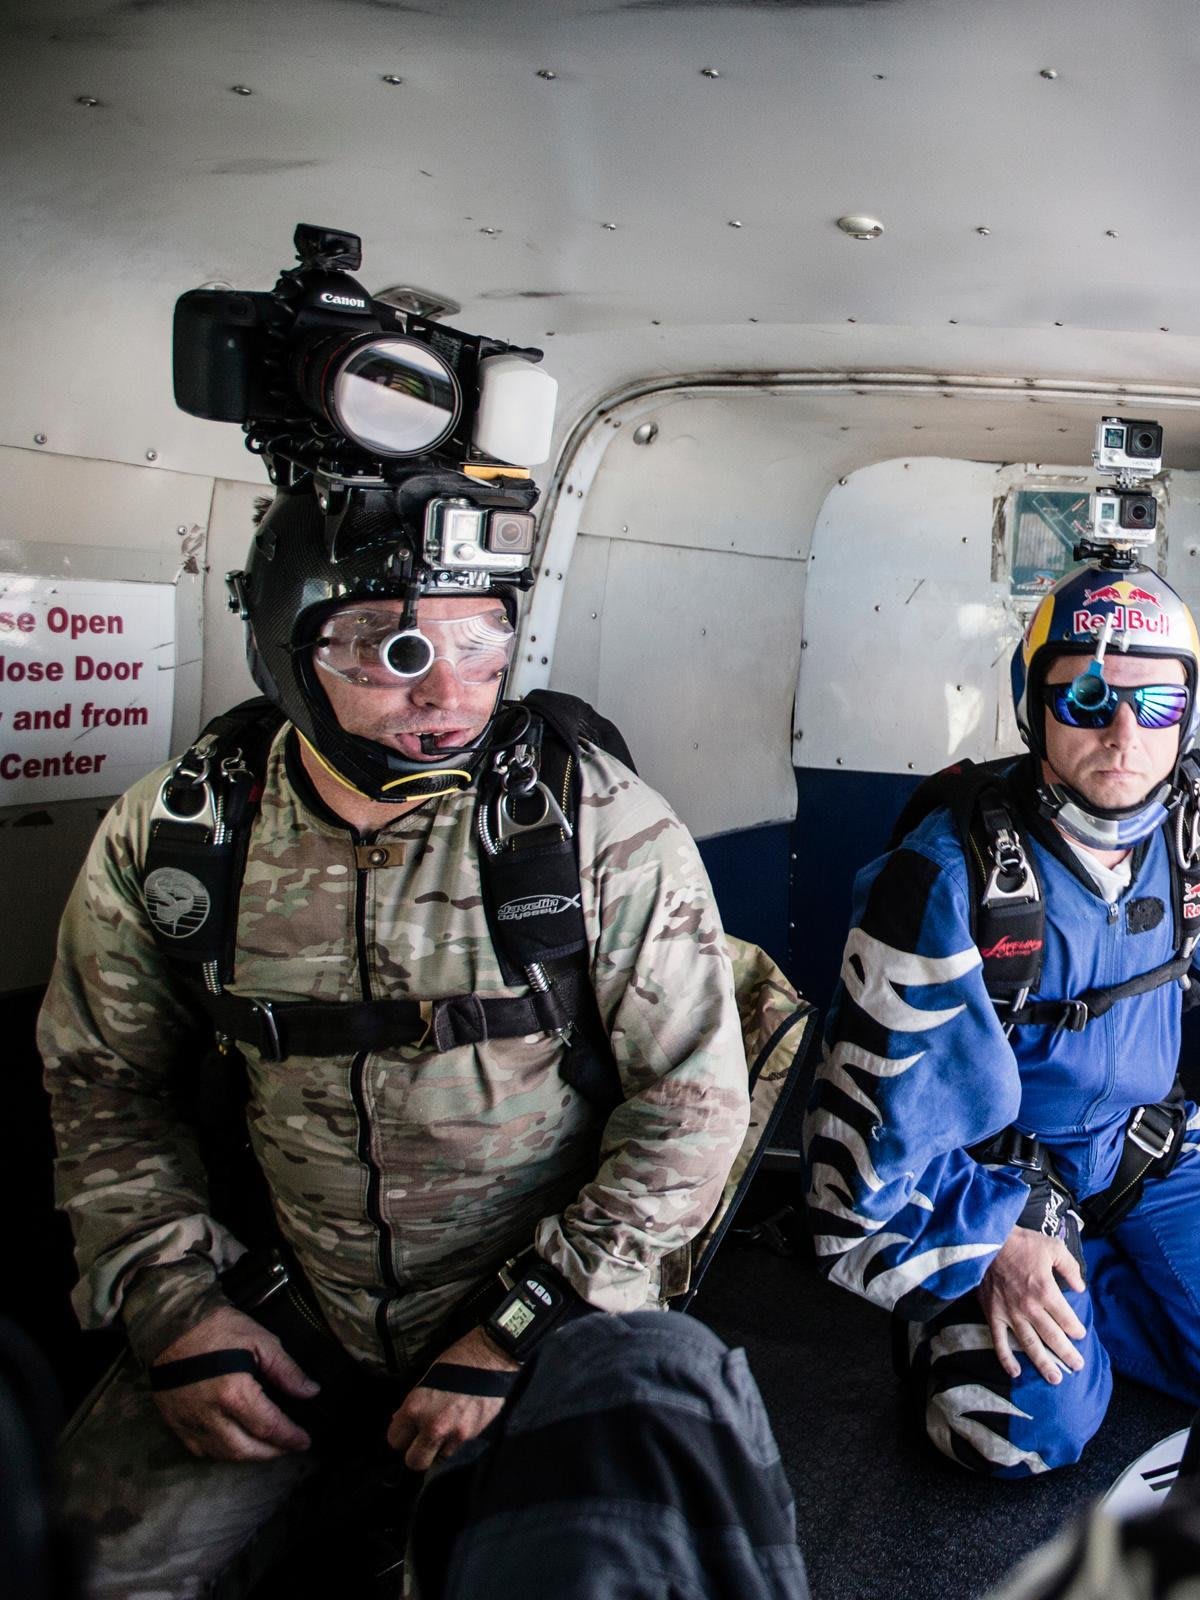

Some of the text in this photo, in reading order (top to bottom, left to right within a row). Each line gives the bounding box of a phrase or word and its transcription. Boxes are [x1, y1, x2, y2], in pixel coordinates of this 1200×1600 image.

[321, 292, 366, 308] Canon
[47, 606, 124, 640] Open
[1073, 606, 1170, 637] Red Bull
[75, 655, 143, 681] Door
[13, 703, 72, 731] and
[81, 702, 149, 728] from
[0, 751, 107, 780] Center
